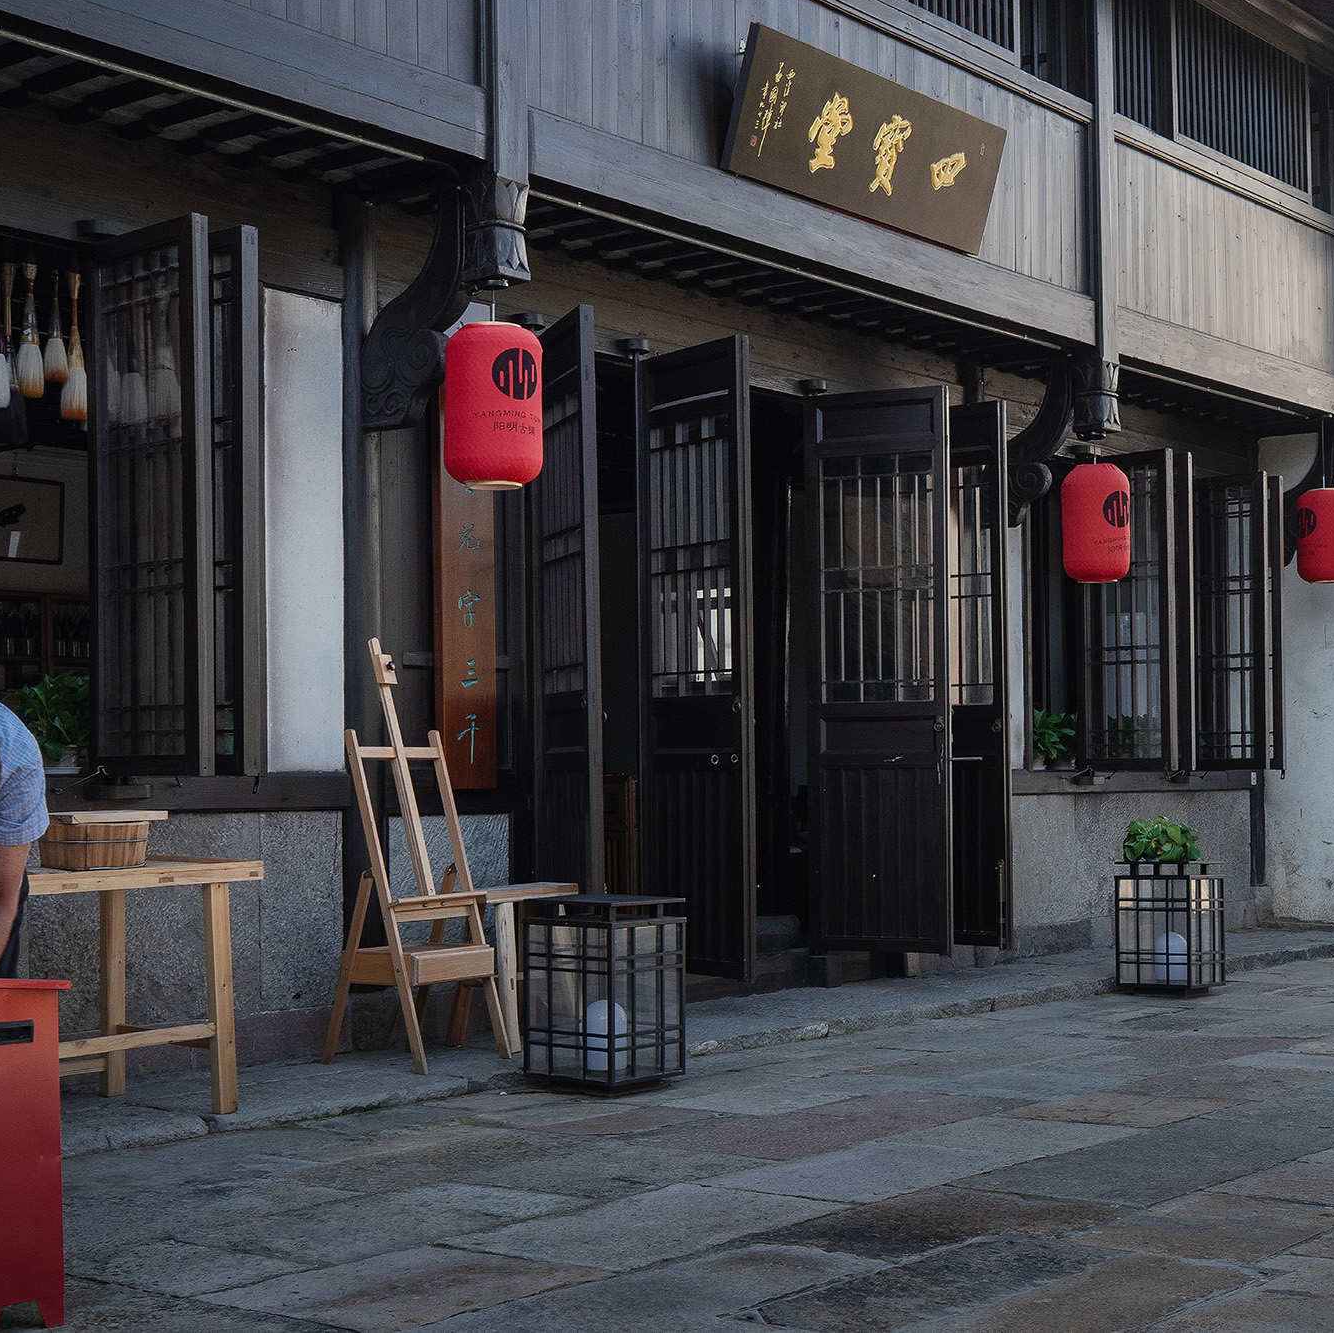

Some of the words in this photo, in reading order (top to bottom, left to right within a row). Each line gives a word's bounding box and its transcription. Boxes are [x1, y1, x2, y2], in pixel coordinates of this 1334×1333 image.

[473, 409, 527, 419] YANGMING
[493, 421, 536, 437] 阳明古镇
